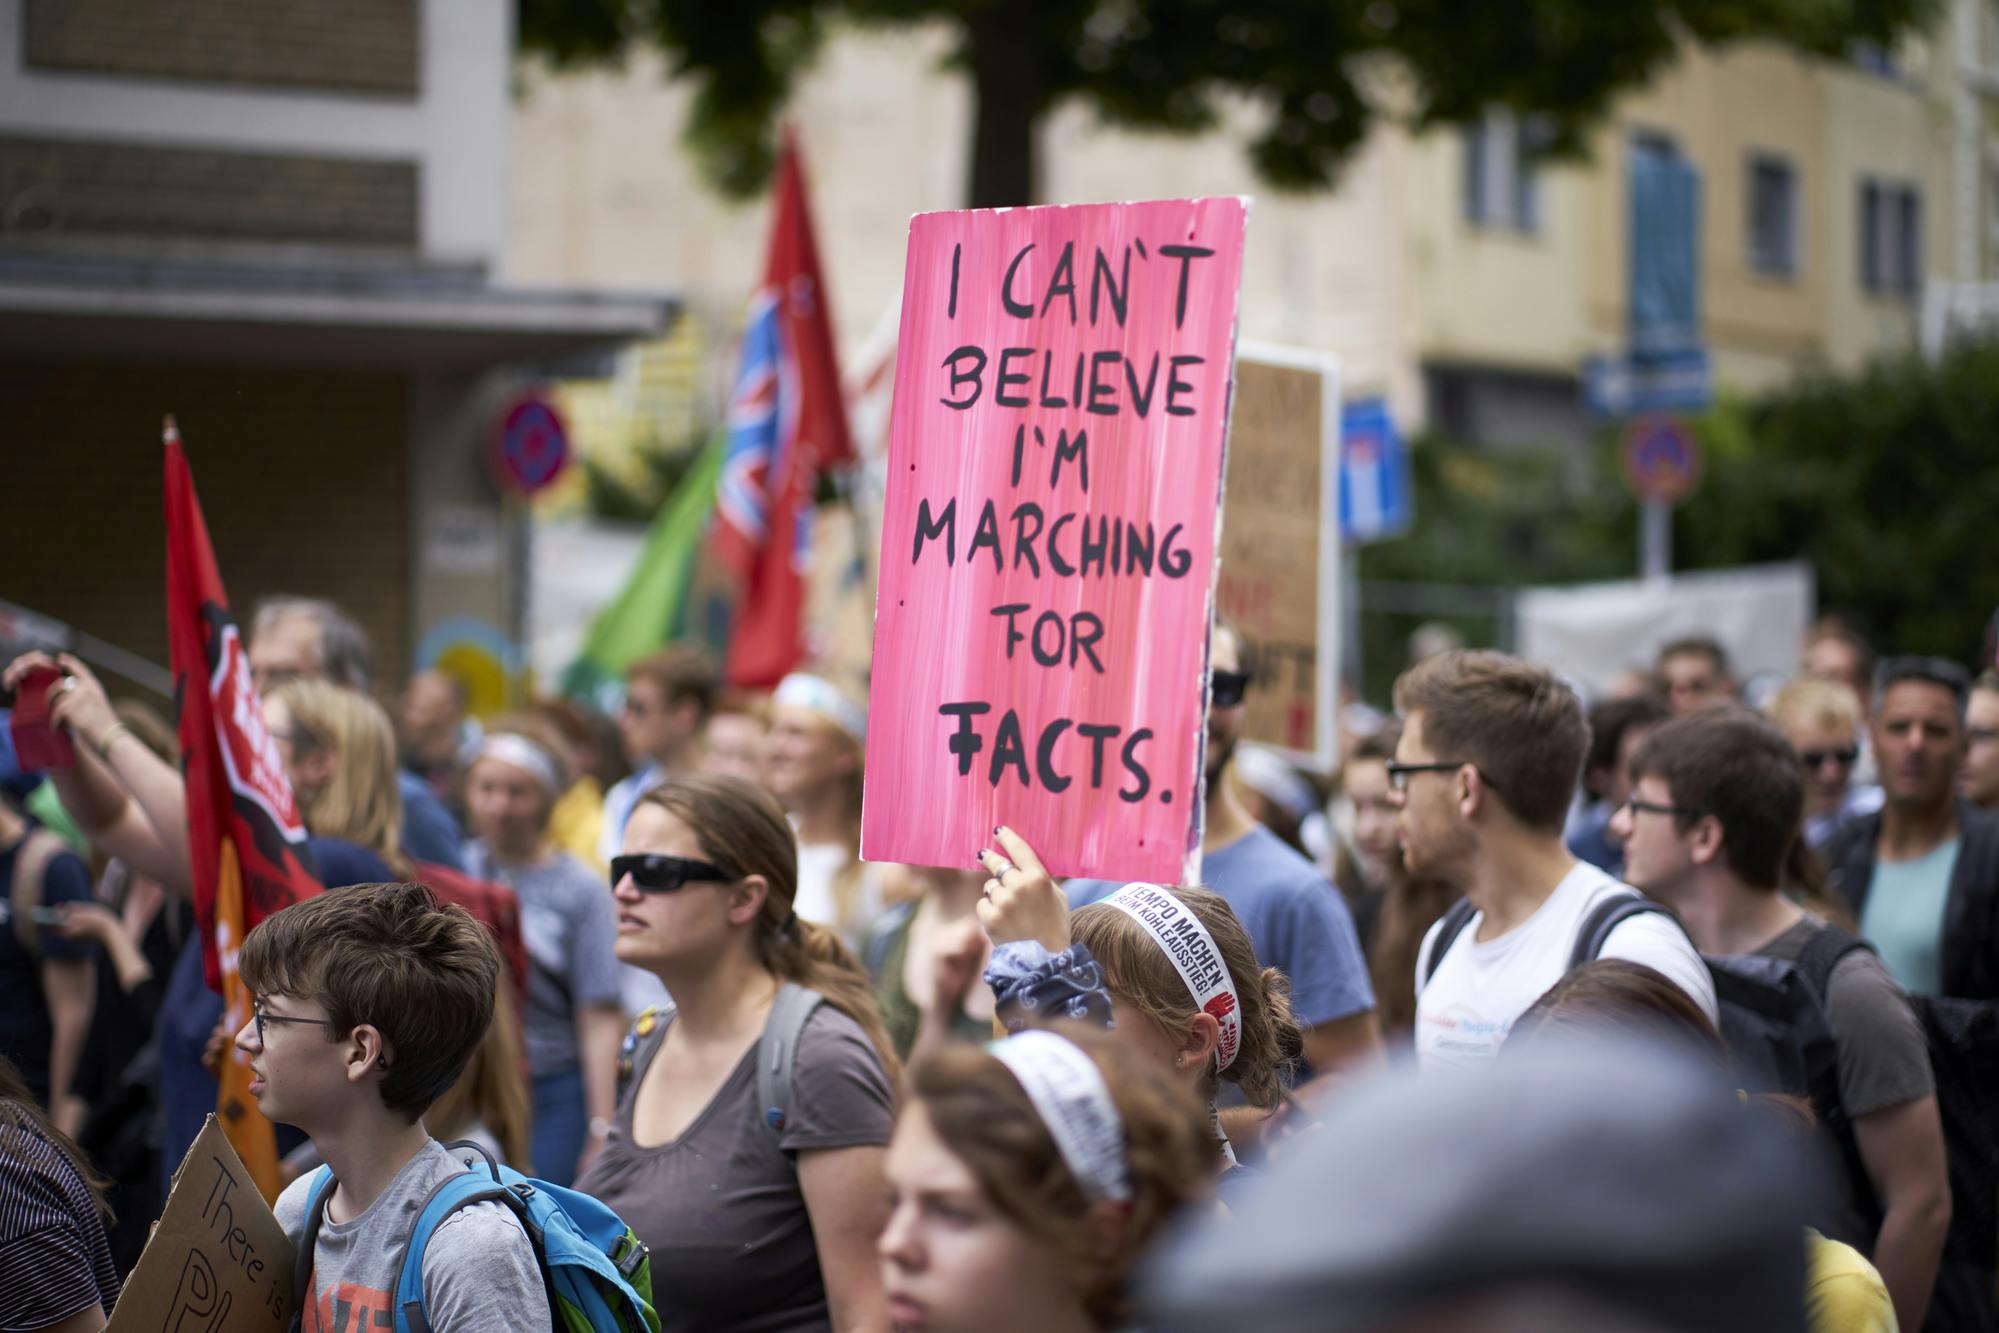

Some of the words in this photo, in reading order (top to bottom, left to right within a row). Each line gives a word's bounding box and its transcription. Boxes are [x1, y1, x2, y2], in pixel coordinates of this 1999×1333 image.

[948, 242, 962, 319] I
[1001, 237, 1215, 330] CAN'T
[940, 345, 1205, 418] BELIEVE
[1011, 423, 1088, 494] I'M
[912, 497, 1192, 578] MARCHING
[990, 603, 1105, 673] FOR
[938, 701, 1173, 803] FACTS.
[1128, 887, 1178, 919] TEMPO
[1171, 917, 1224, 988] MACHEN
[1138, 907, 1210, 996] KOHLEAUSSTIEG!
[202, 1156, 264, 1282] There
[265, 1281, 284, 1320] is
